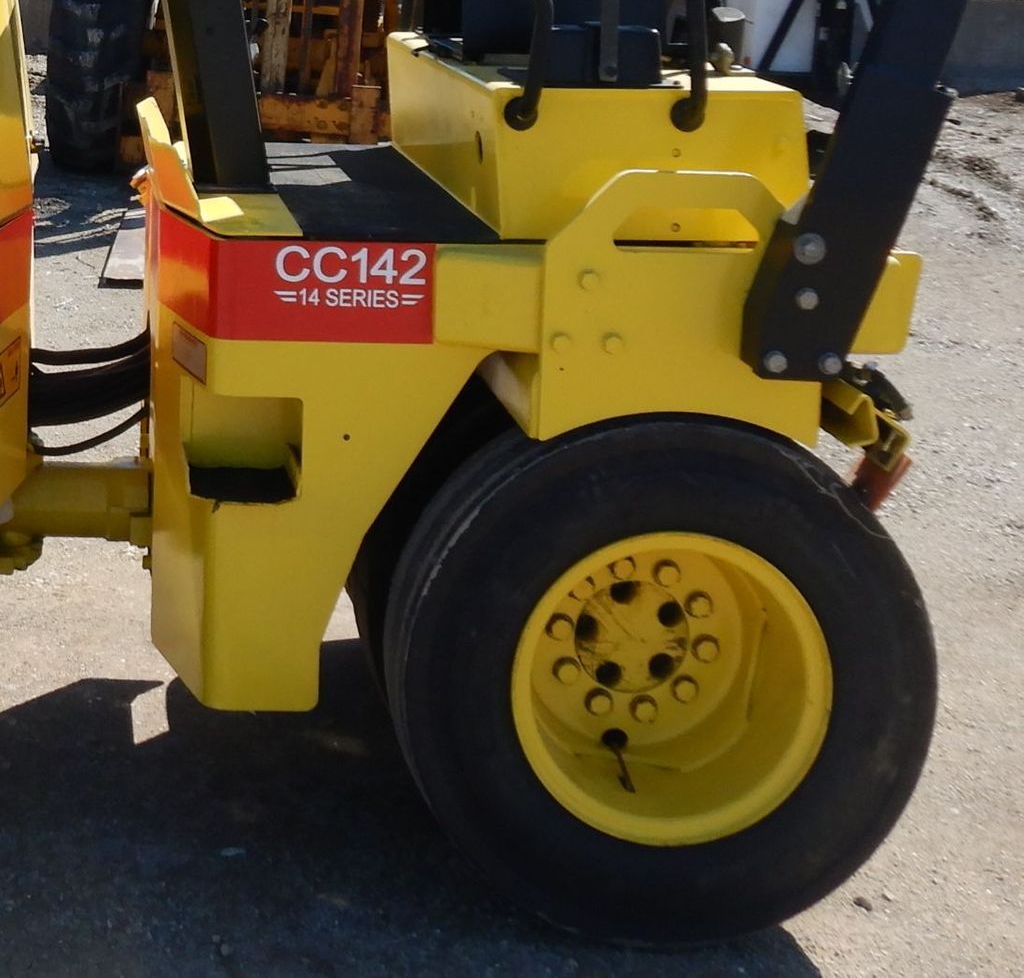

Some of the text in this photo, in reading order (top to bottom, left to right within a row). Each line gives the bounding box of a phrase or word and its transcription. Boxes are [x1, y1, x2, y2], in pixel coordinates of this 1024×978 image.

[274, 244, 427, 286] CC142
[299, 288, 399, 309] 14 SERIES
